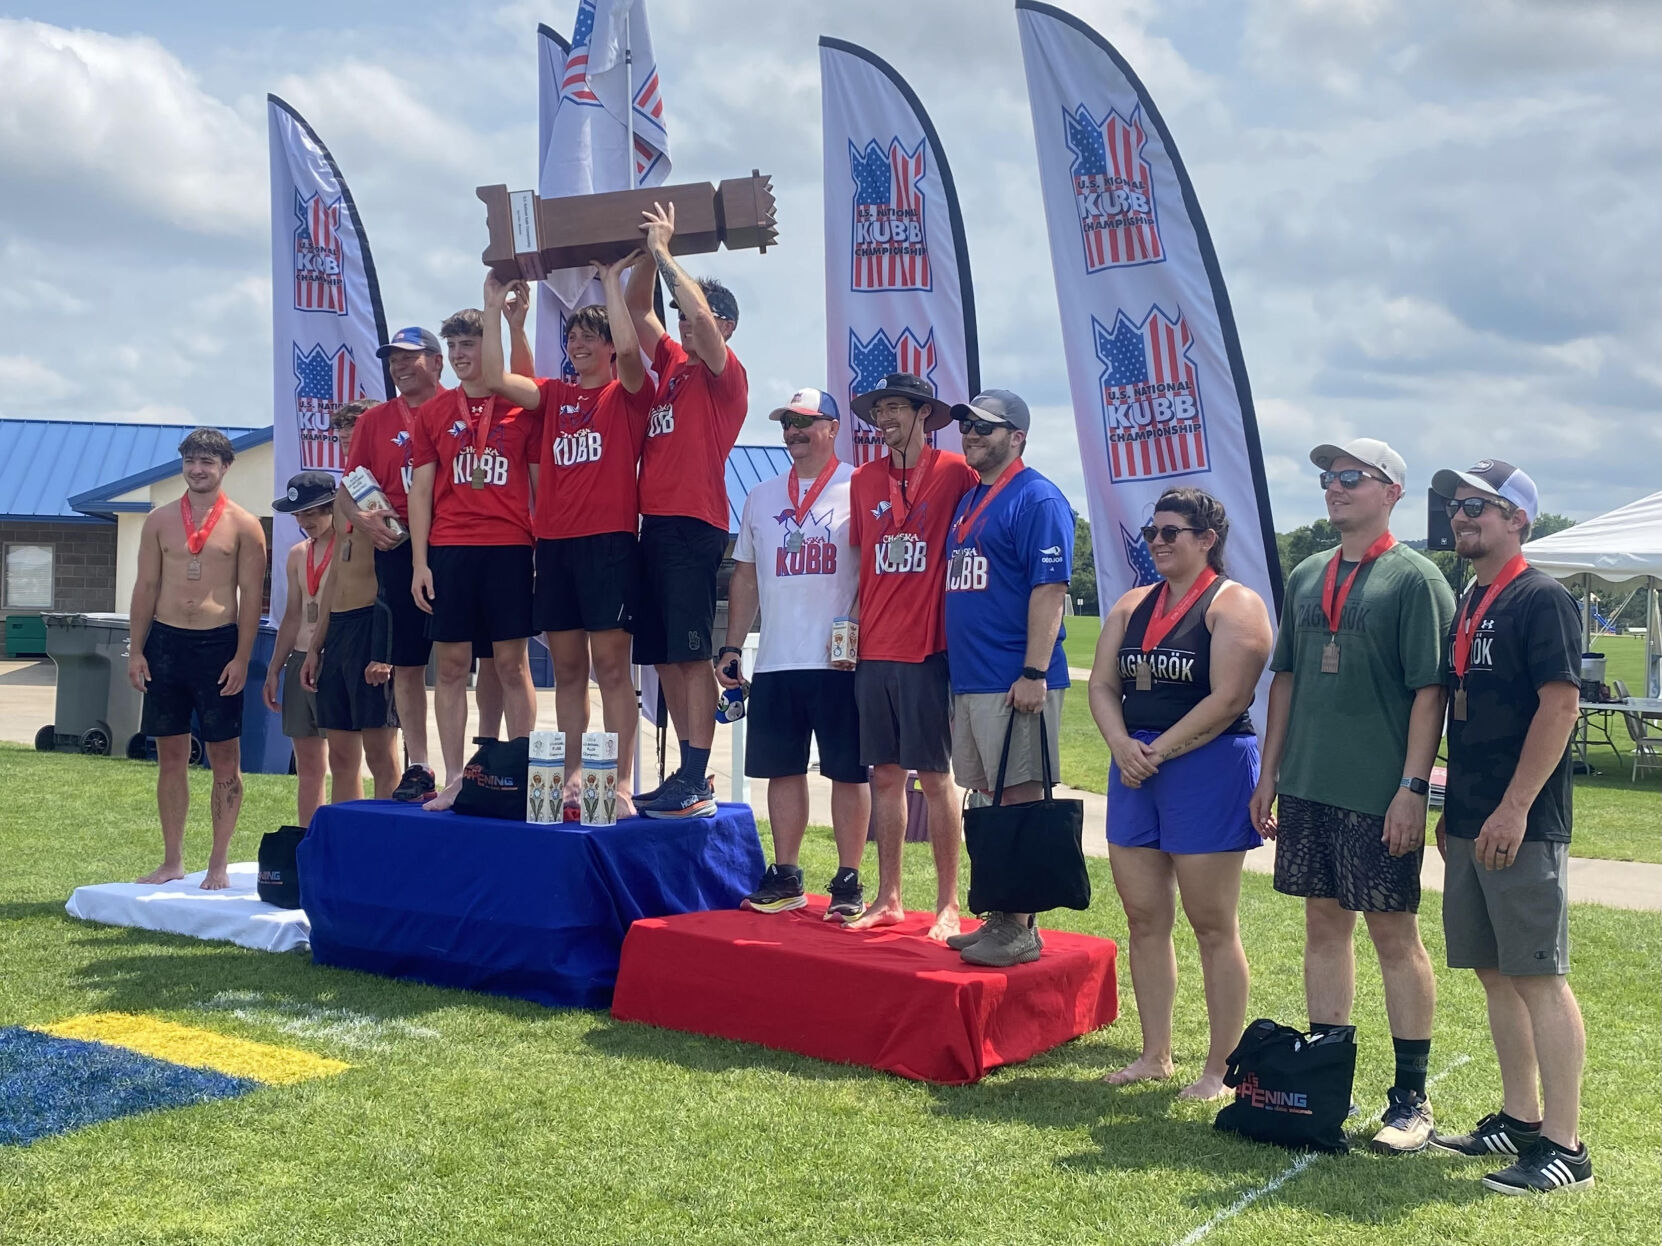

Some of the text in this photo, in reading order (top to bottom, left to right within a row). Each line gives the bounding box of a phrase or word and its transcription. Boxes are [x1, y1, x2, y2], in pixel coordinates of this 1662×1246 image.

[1077, 180, 1100, 189] U.S.
[1076, 189, 1152, 219] KUBB
[856, 219, 923, 245] KUBB
[1083, 216, 1155, 232] CHAMPISHIP
[1108, 380, 1192, 400] U.S. NATIONAL
[317, 402, 344, 410] NATIO
[1107, 394, 1199, 430] KUBB
[298, 411, 332, 432] KU
[1109, 423, 1202, 443] CHAMPIONSHIP
[301, 433, 339, 443] CHAMPIO
[552, 431, 602, 466] KUBB
[452, 453, 509, 486] KUBB
[775, 543, 837, 577] KUBB
[1117, 651, 1194, 682] AGARÖK
